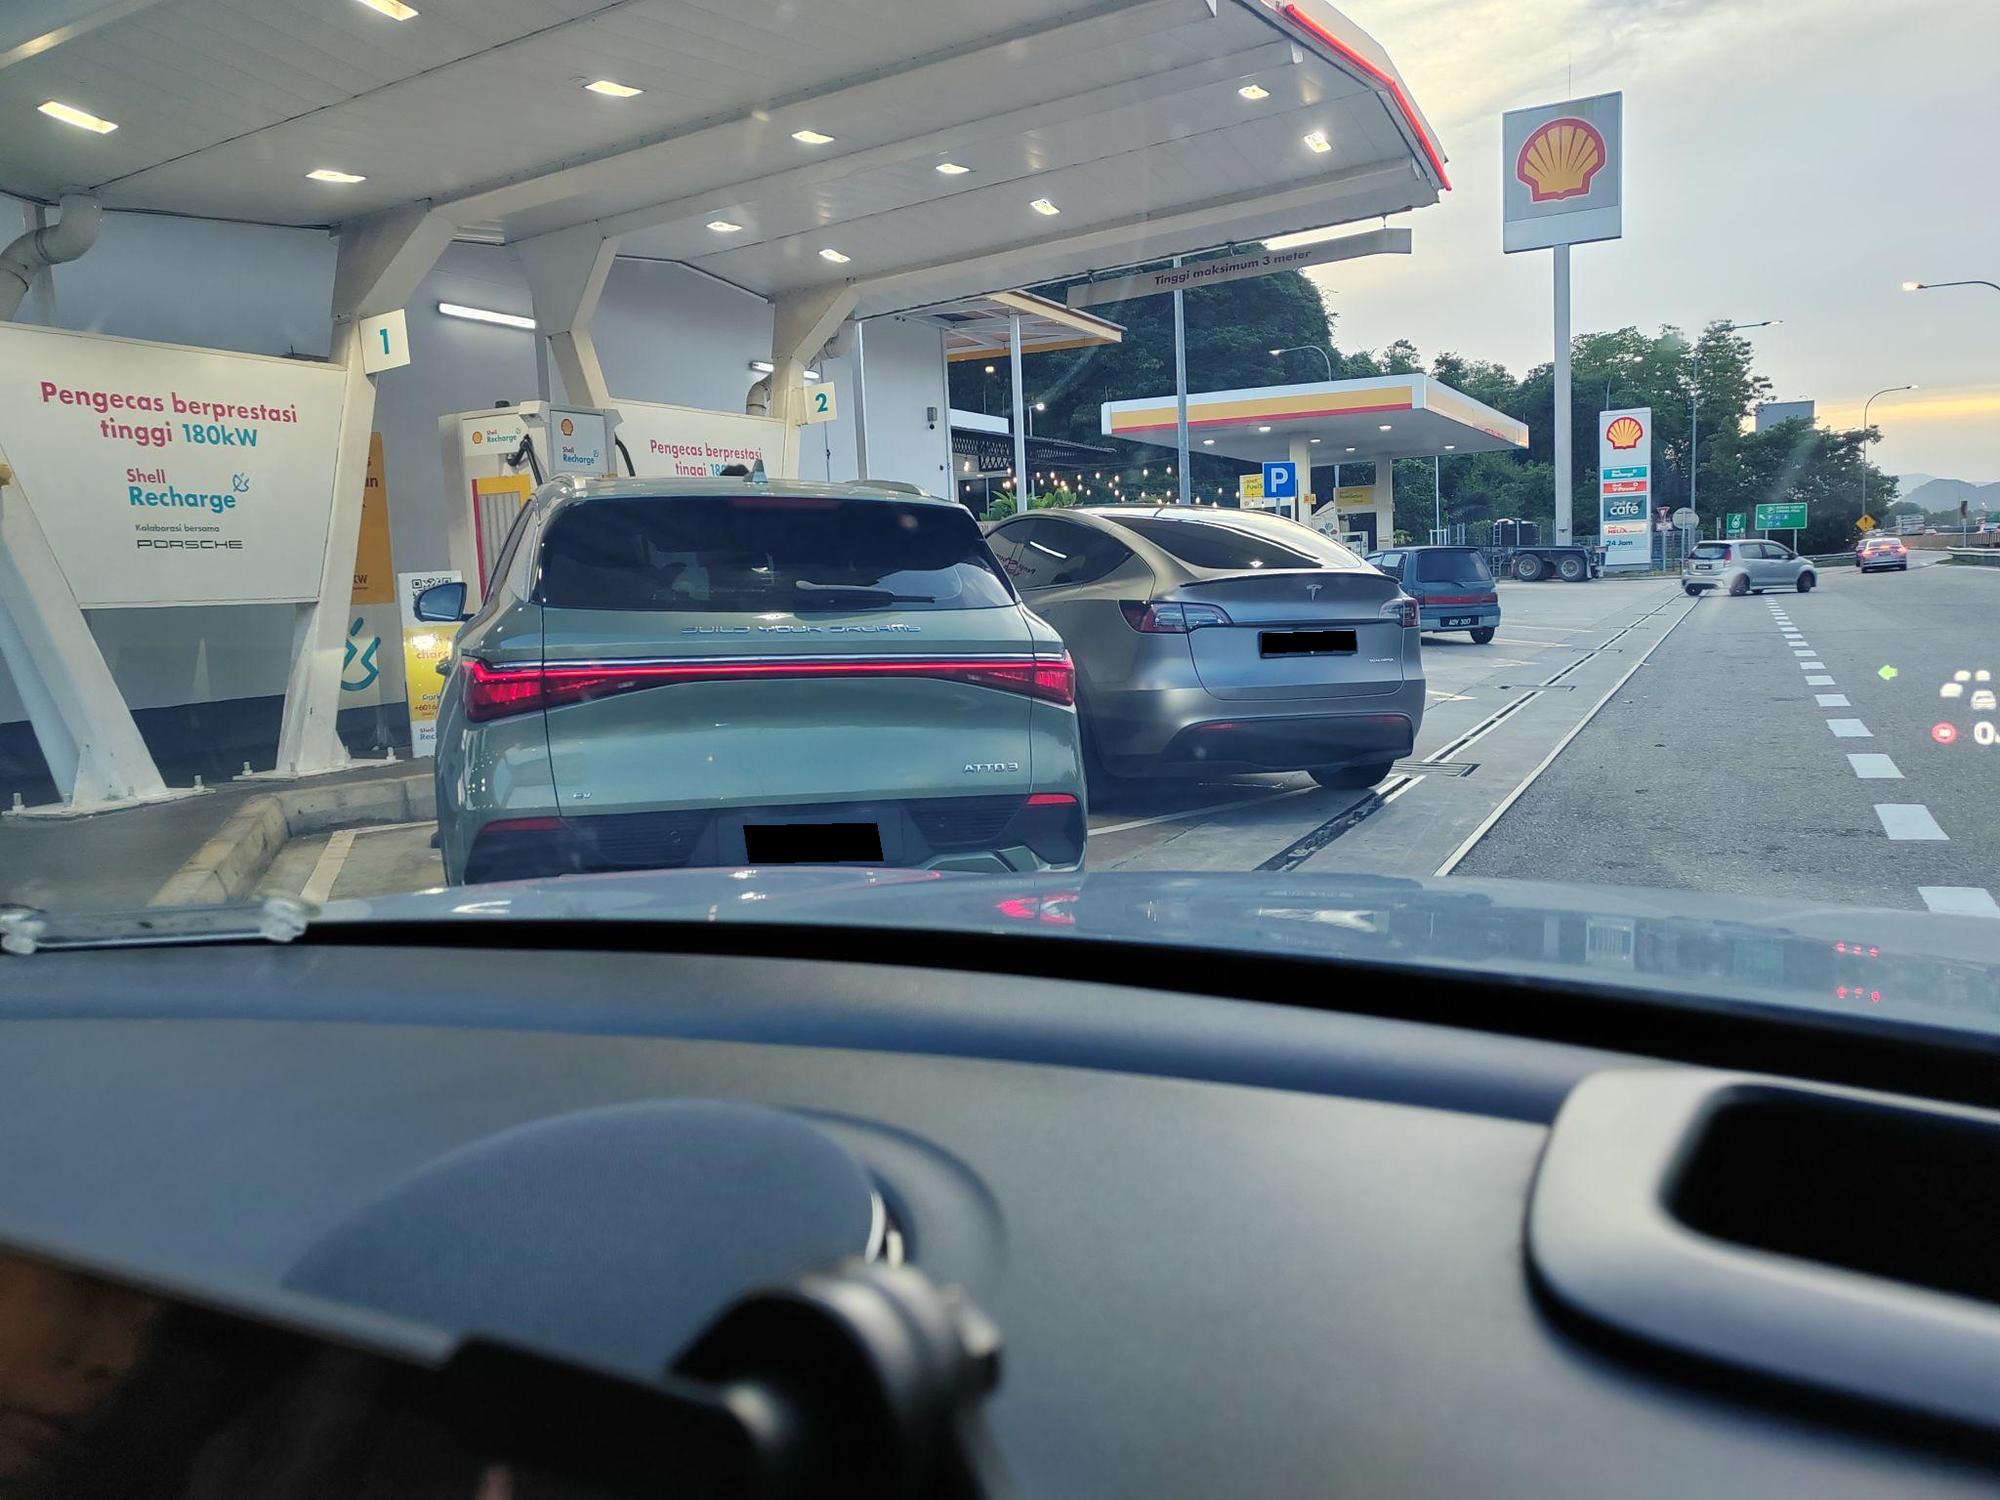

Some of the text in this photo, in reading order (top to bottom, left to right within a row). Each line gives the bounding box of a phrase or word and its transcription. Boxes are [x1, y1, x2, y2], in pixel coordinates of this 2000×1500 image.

[1154, 249, 1312, 286] Tinggi maksimum 3 meter
[379, 328, 390, 355] 1
[40, 381, 298, 423] Pengecas berprestasi
[815, 393, 828, 413] 2
[100, 417, 258, 448] tinggi 180kW
[486, 433, 518, 443] Recharge
[650, 439, 762, 461] Pengecas berprestasi
[562, 454, 595, 466] Recharge
[127, 468, 166, 484] Shell
[1271, 468, 1289, 493] P
[128, 486, 237, 514] Recharge
[1610, 501, 1639, 516] café
[184, 524, 220, 533] bersama
[136, 539, 243, 550] PORSCHE
[758, 624, 823, 634] YOUR
[964, 762, 1018, 773] ATTO 3
